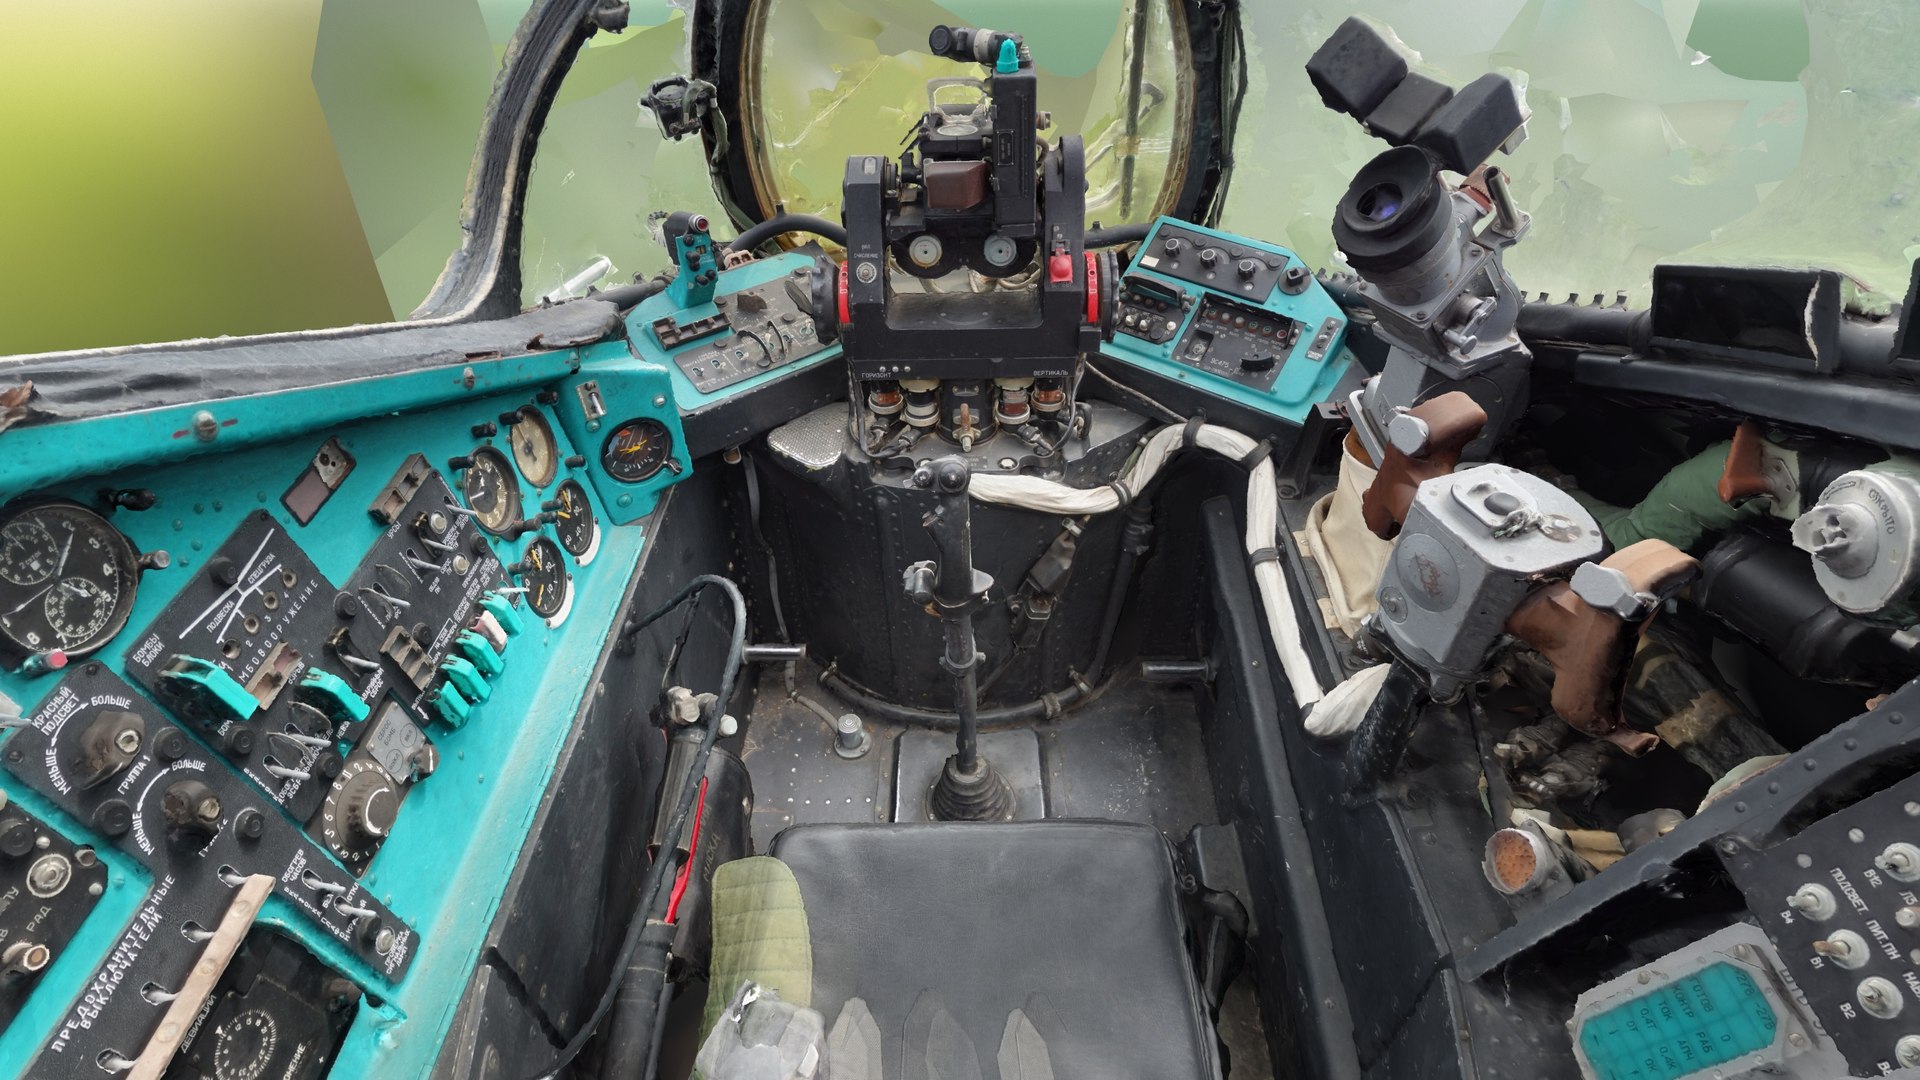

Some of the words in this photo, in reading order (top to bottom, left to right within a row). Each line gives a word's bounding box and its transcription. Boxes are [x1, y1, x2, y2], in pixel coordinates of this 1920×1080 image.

[1033, 369, 1069, 377] ВЕРТИКАЛЬ
[88, 538, 101, 549] 3
[103, 563, 114, 576] 4
[48, 608, 58, 617] 50
[206, 599, 236, 633] ПОДВЕСКА
[27, 632, 41, 645] 8
[132, 633, 160, 663] БОМБЫ
[142, 641, 166, 667] БЛОКИ
[369, 680, 385, 699] СБРОС
[31, 686, 72, 730] КРАСНЫЙ
[91, 695, 132, 709] БОЛЬШЕ
[40, 693, 81, 736] ПОДСВЕТ
[377, 719, 392, 741] СБРОС
[382, 727, 396, 746] БОМБ
[45, 747, 72, 796] МЕНЬШЕ
[171, 759, 207, 772] БОЛЬШЕ
[117, 761, 145, 796] ГРУППА
[132, 811, 156, 856] МЕНЬШЕ
[281, 848, 305, 884] ОБОГРЕВ
[289, 857, 307, 882] ЧАСОВ
[1863, 868, 1883, 888] В12
[346, 881, 361, 902] ОТКЛ
[1830, 867, 1870, 916] ПОДСВЕТ.
[26, 904, 52, 933] РАД
[1780, 909, 1795, 924] В4
[50, 874, 176, 1053] ПРЕДОХРАНИТЕЛЬНЫЕ
[80, 912, 163, 1031] ВЫКЛЮЧАТЕЛИ
[1809, 955, 1825, 971] В1
[1671, 984, 1694, 1018] КОНТР
[1689, 978, 1713, 1013] ГОТОВ
[1658, 1001, 1673, 1022] ТОК
[1839, 1002, 1856, 1020] В2
[181, 994, 217, 1054] ДЕВИАЦИИ
[1677, 1039, 1695, 1060] АПЧ
[1696, 1031, 1713, 1054] РАБ
